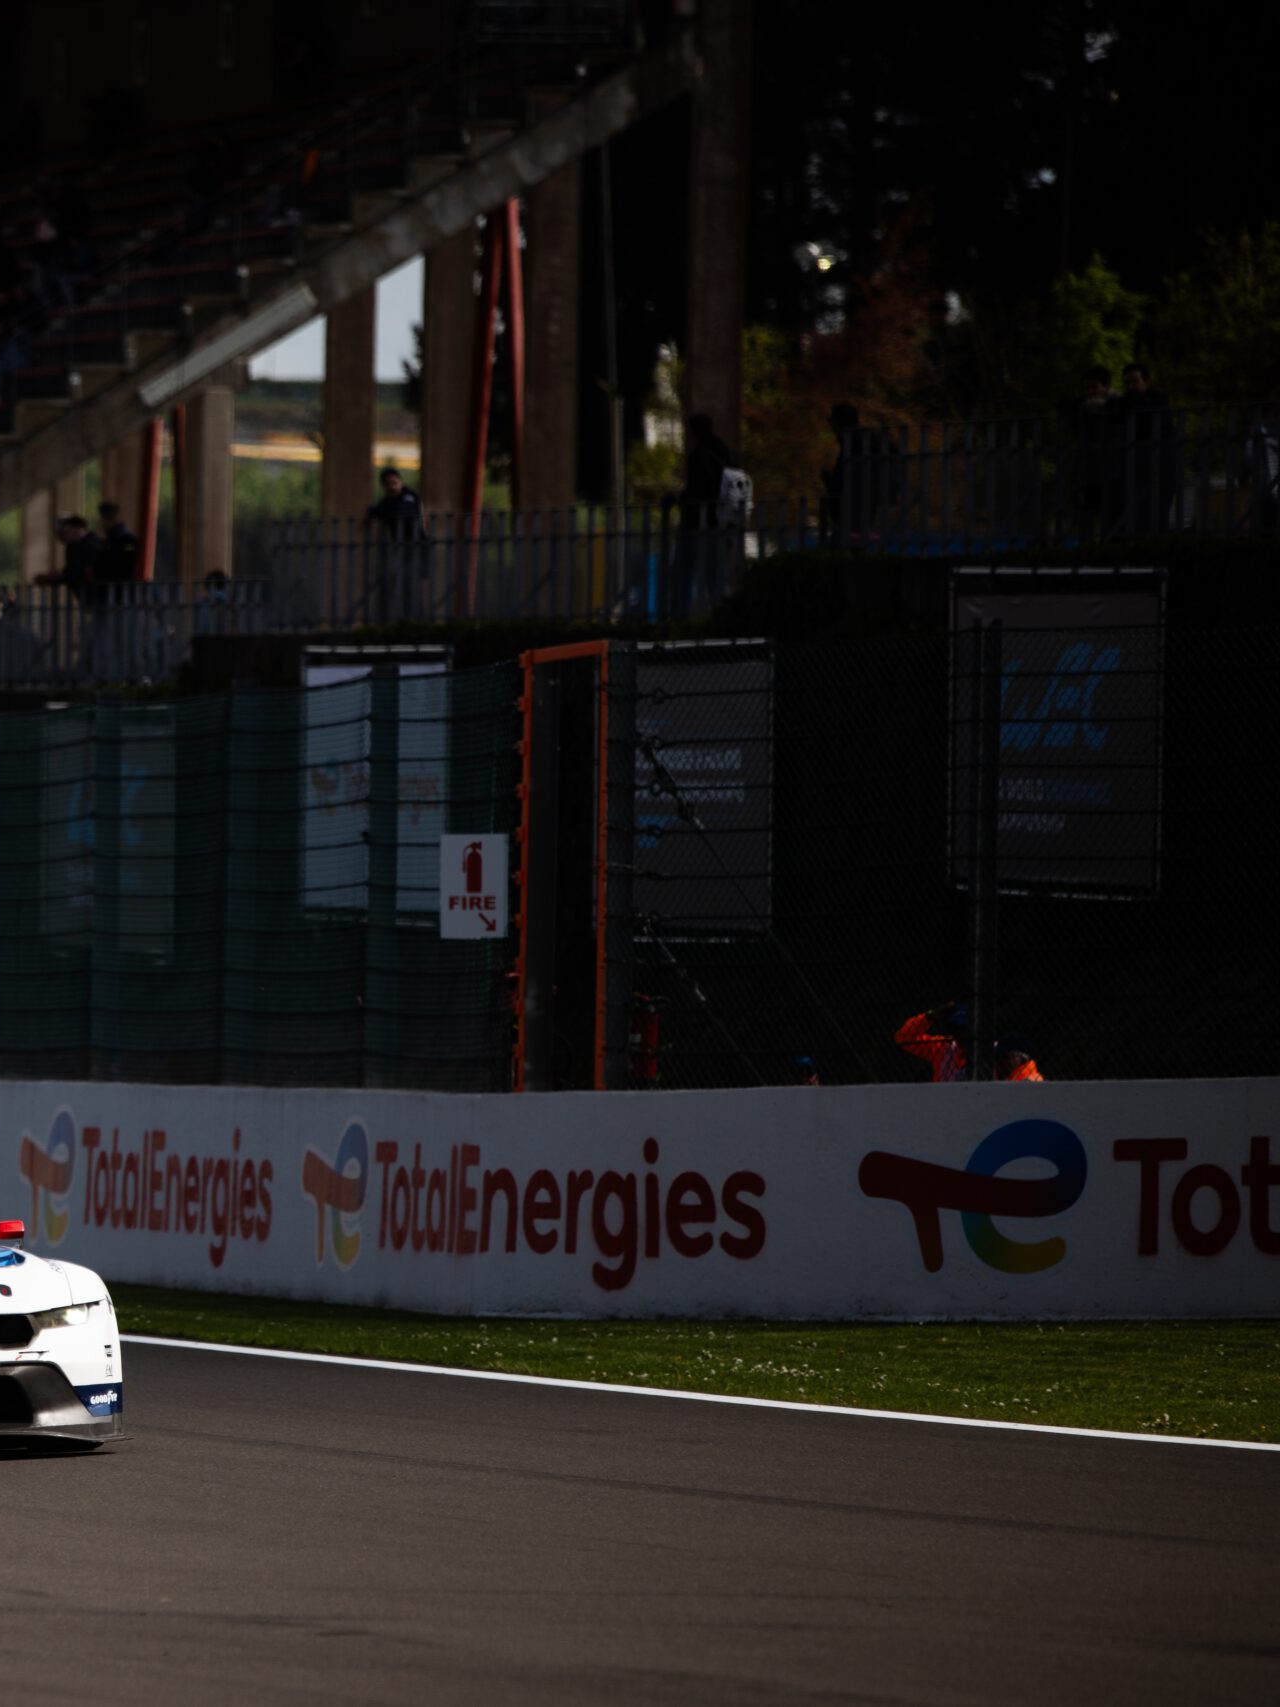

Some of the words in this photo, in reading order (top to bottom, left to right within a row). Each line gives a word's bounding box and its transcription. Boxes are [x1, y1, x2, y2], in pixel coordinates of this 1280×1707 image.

[449, 896, 496, 911] FIRE
[82, 1127, 273, 1268] TotalEnergies
[374, 1137, 767, 1291] TotalEnergies
